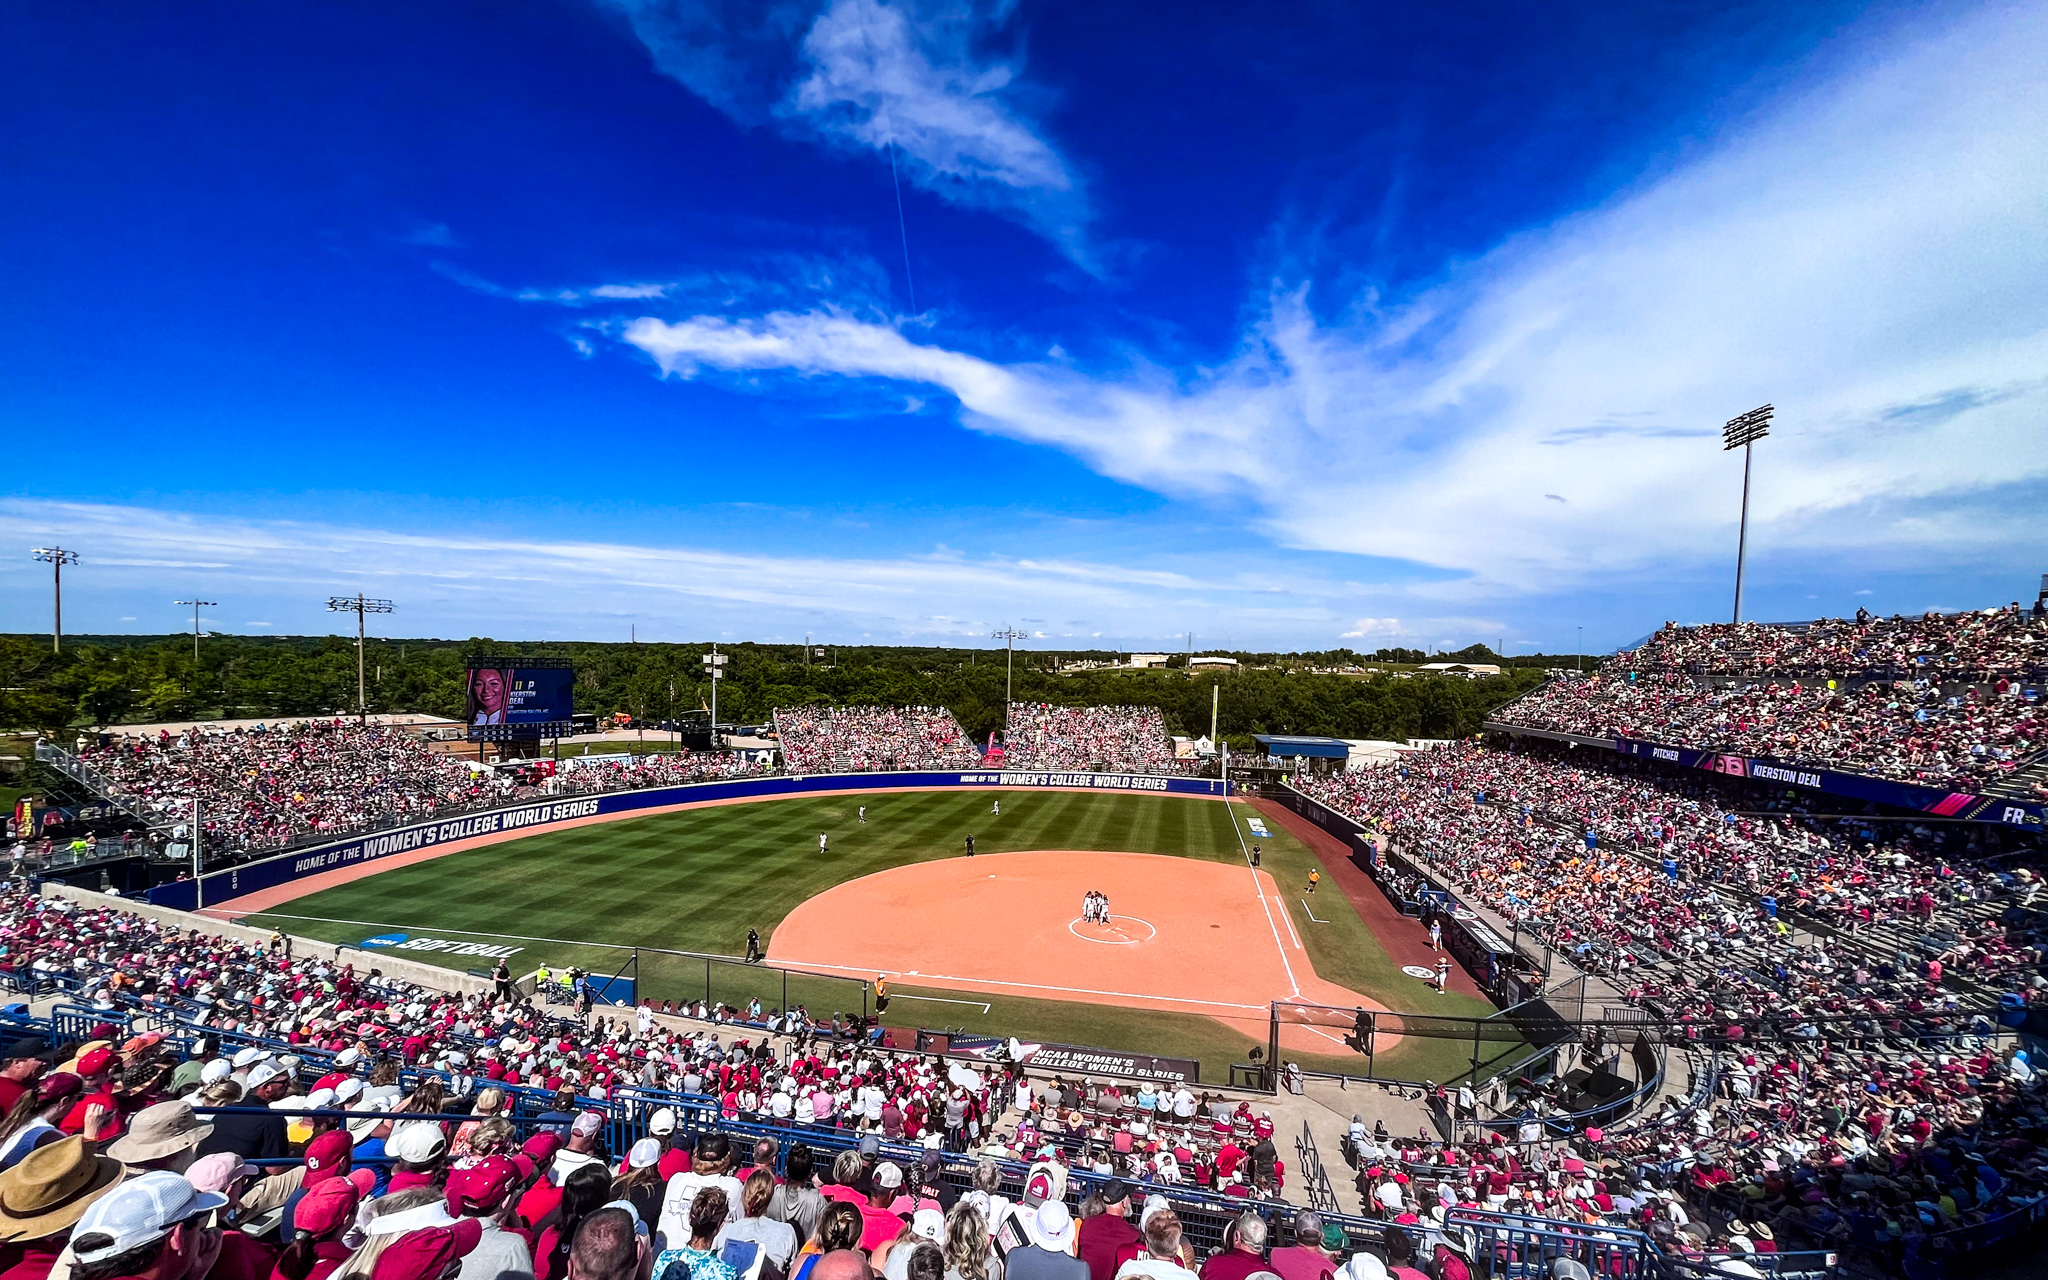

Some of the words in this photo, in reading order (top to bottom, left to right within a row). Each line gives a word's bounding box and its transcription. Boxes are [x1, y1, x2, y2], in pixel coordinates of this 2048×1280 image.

[515, 681, 523, 690] 11
[528, 681, 535, 690] P
[1652, 747, 1679, 761] PITCHER
[960, 775, 977, 783] HOME
[978, 775, 986, 783] OF
[987, 775, 998, 783] THE
[1000, 774, 1048, 786] WOMEN'S
[1049, 775, 1091, 787] COLLEGE
[1093, 776, 1130, 788] WORLD
[1131, 778, 1168, 790] SERIES
[1753, 764, 1797, 783] KIERSTON
[1797, 771, 1821, 788] DEAL
[2003, 807, 2024, 824] FR
[295, 856, 325, 872] HOME
[327, 851, 341, 863] OF
[342, 846, 360, 860] THE
[363, 825, 436, 859] WOMEN'S
[438, 813, 499, 841] COLLEGE
[502, 804, 550, 829] WORLD
[552, 799, 598, 820] SERIES
[396, 937, 525, 957] SOFTBALL
[1036, 1049, 1068, 1060] NCAA
[1072, 1052, 1134, 1067] WOMEN'S
[1030, 1057, 1084, 1070] COLLEGE
[1086, 1061, 1134, 1075] WORLD
[1137, 1068, 1185, 1081] SERIES
[1022, 1134, 1033, 1143] 24
